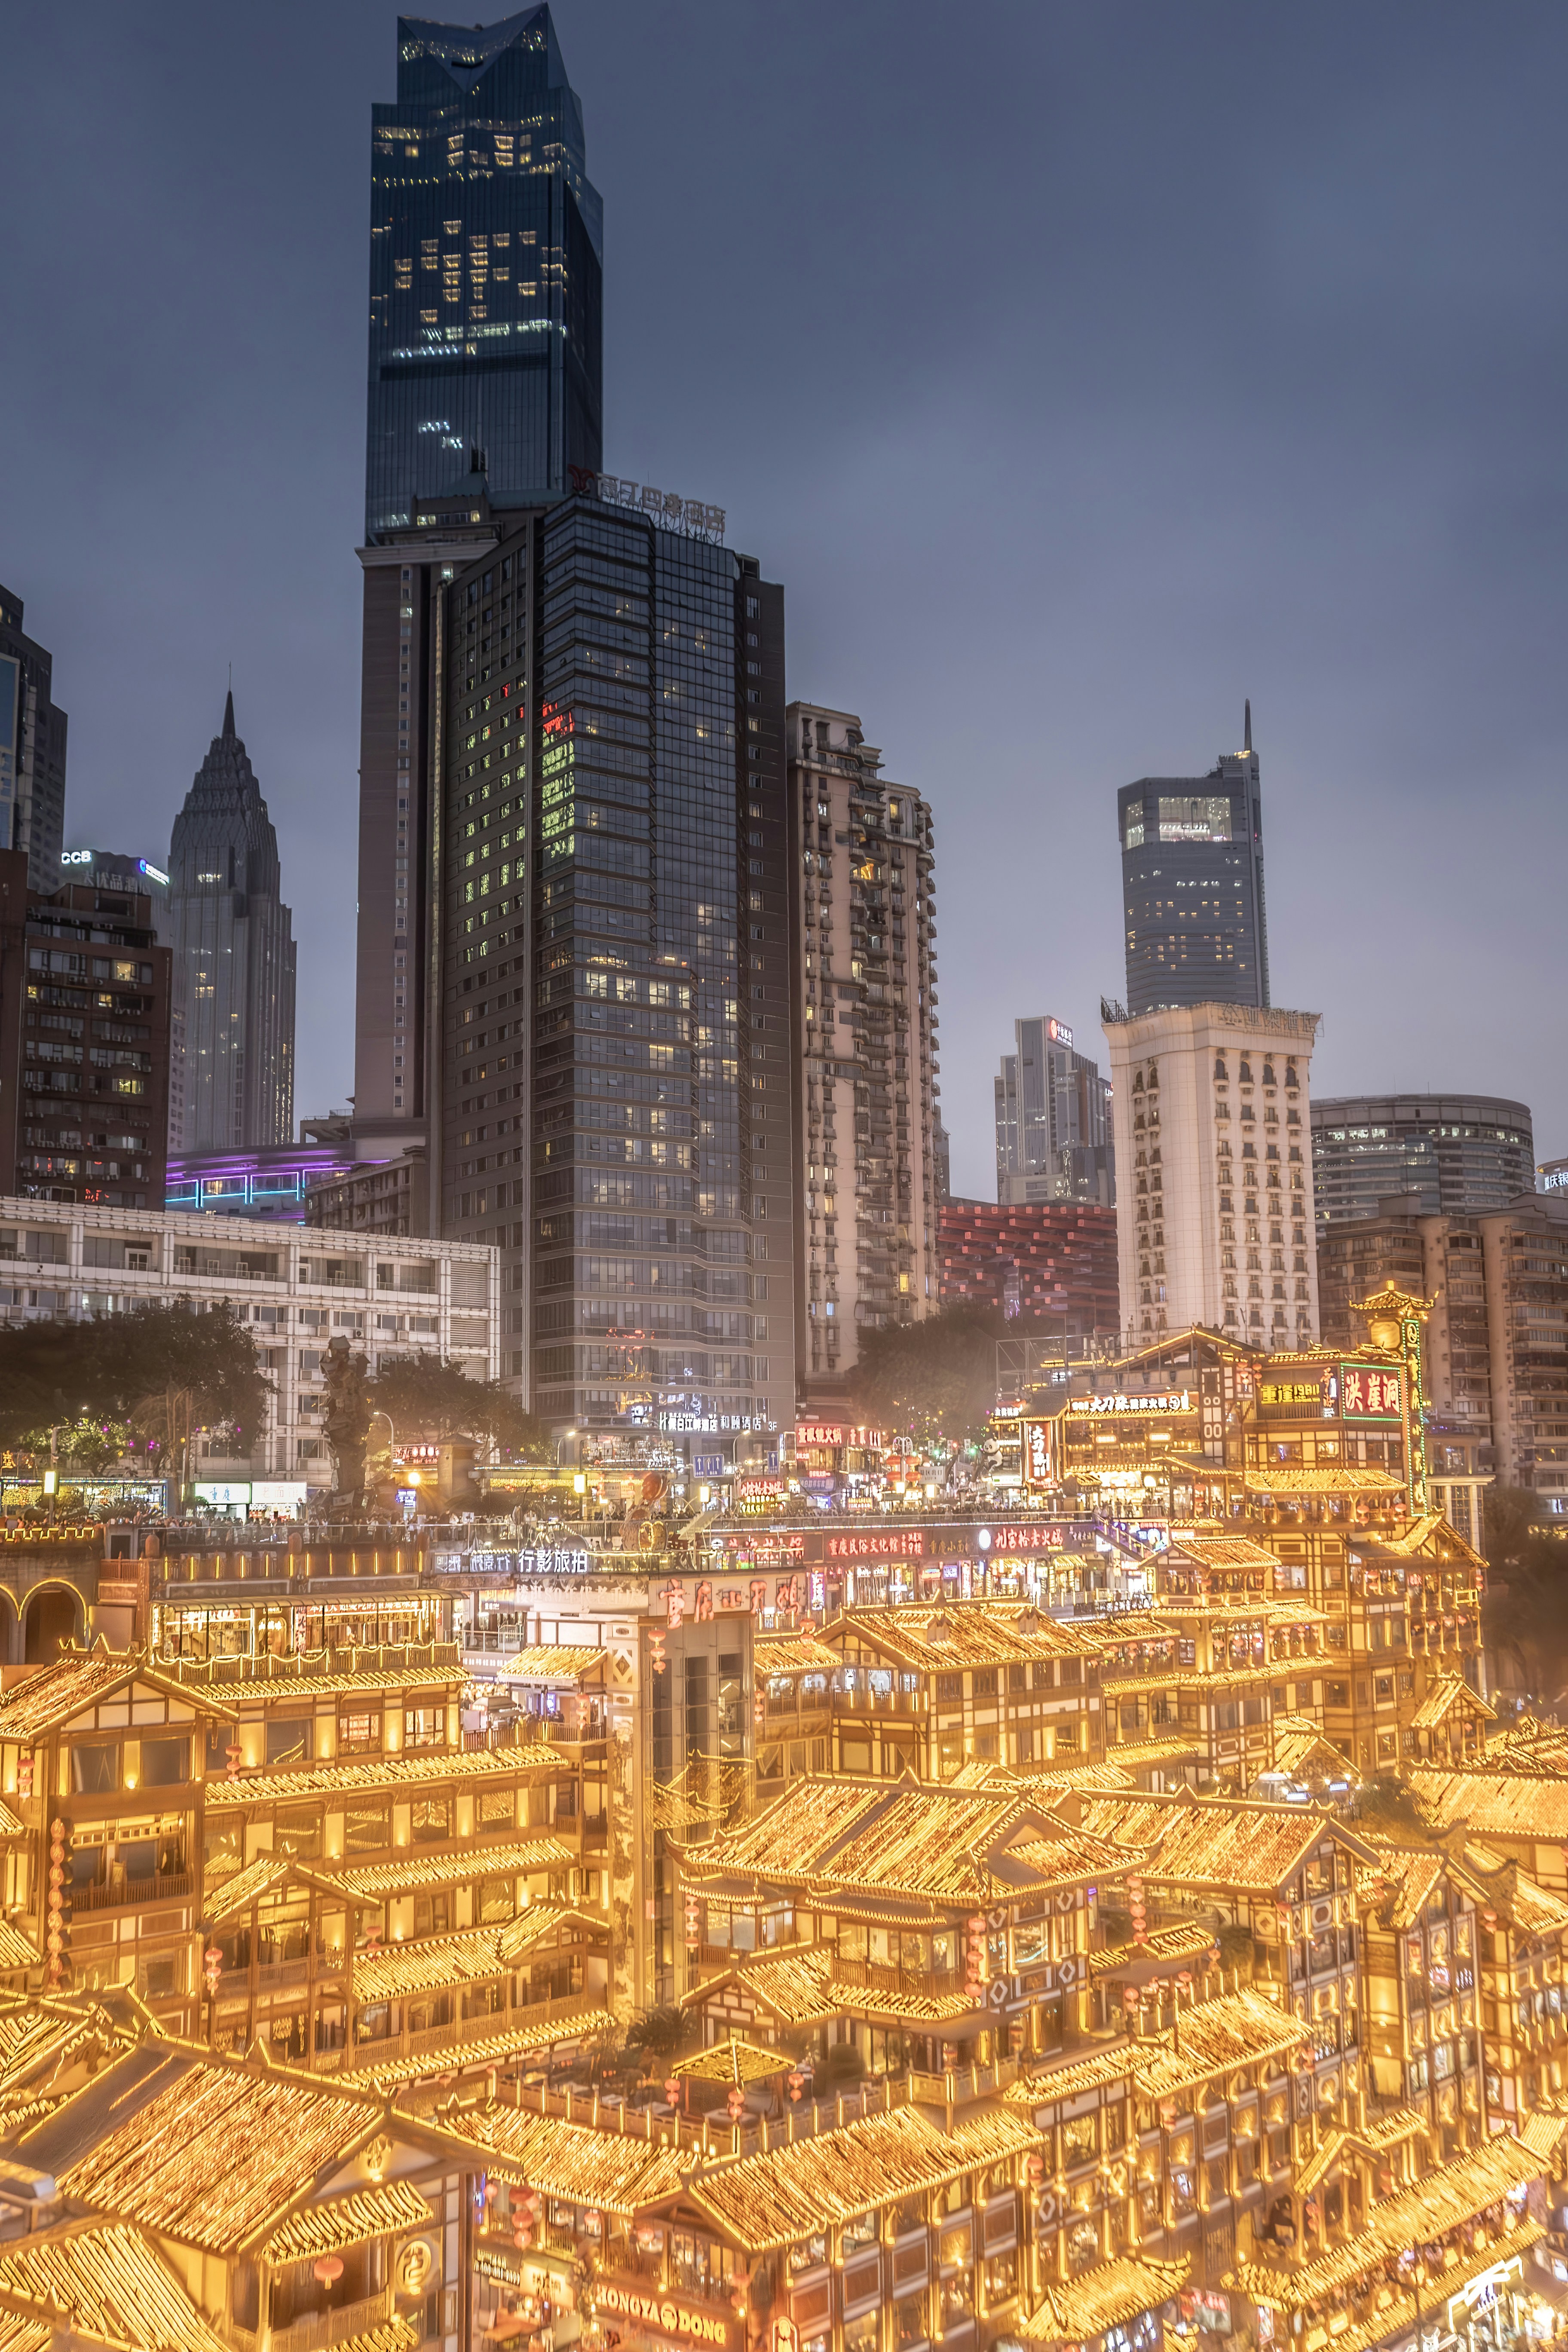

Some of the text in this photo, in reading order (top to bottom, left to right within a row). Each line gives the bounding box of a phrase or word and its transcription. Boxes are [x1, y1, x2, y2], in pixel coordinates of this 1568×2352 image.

[61, 850, 92, 865] CCB
[1057, 1024, 1072, 1041] 中信银行
[1345, 1371, 1400, 1413] 洪崖洞
[720, 1415, 778, 1431] 和颐酒店 3F
[261, 1486, 299, 1498] 老面馆
[829, 1536, 898, 1557] 重庆民俗文化馆
[995, 1527, 1063, 1549] 九宫格老火锅
[518, 1548, 588, 1573] 行影旅拍
[596, 2283, 726, 2346] HONGYA DONG
